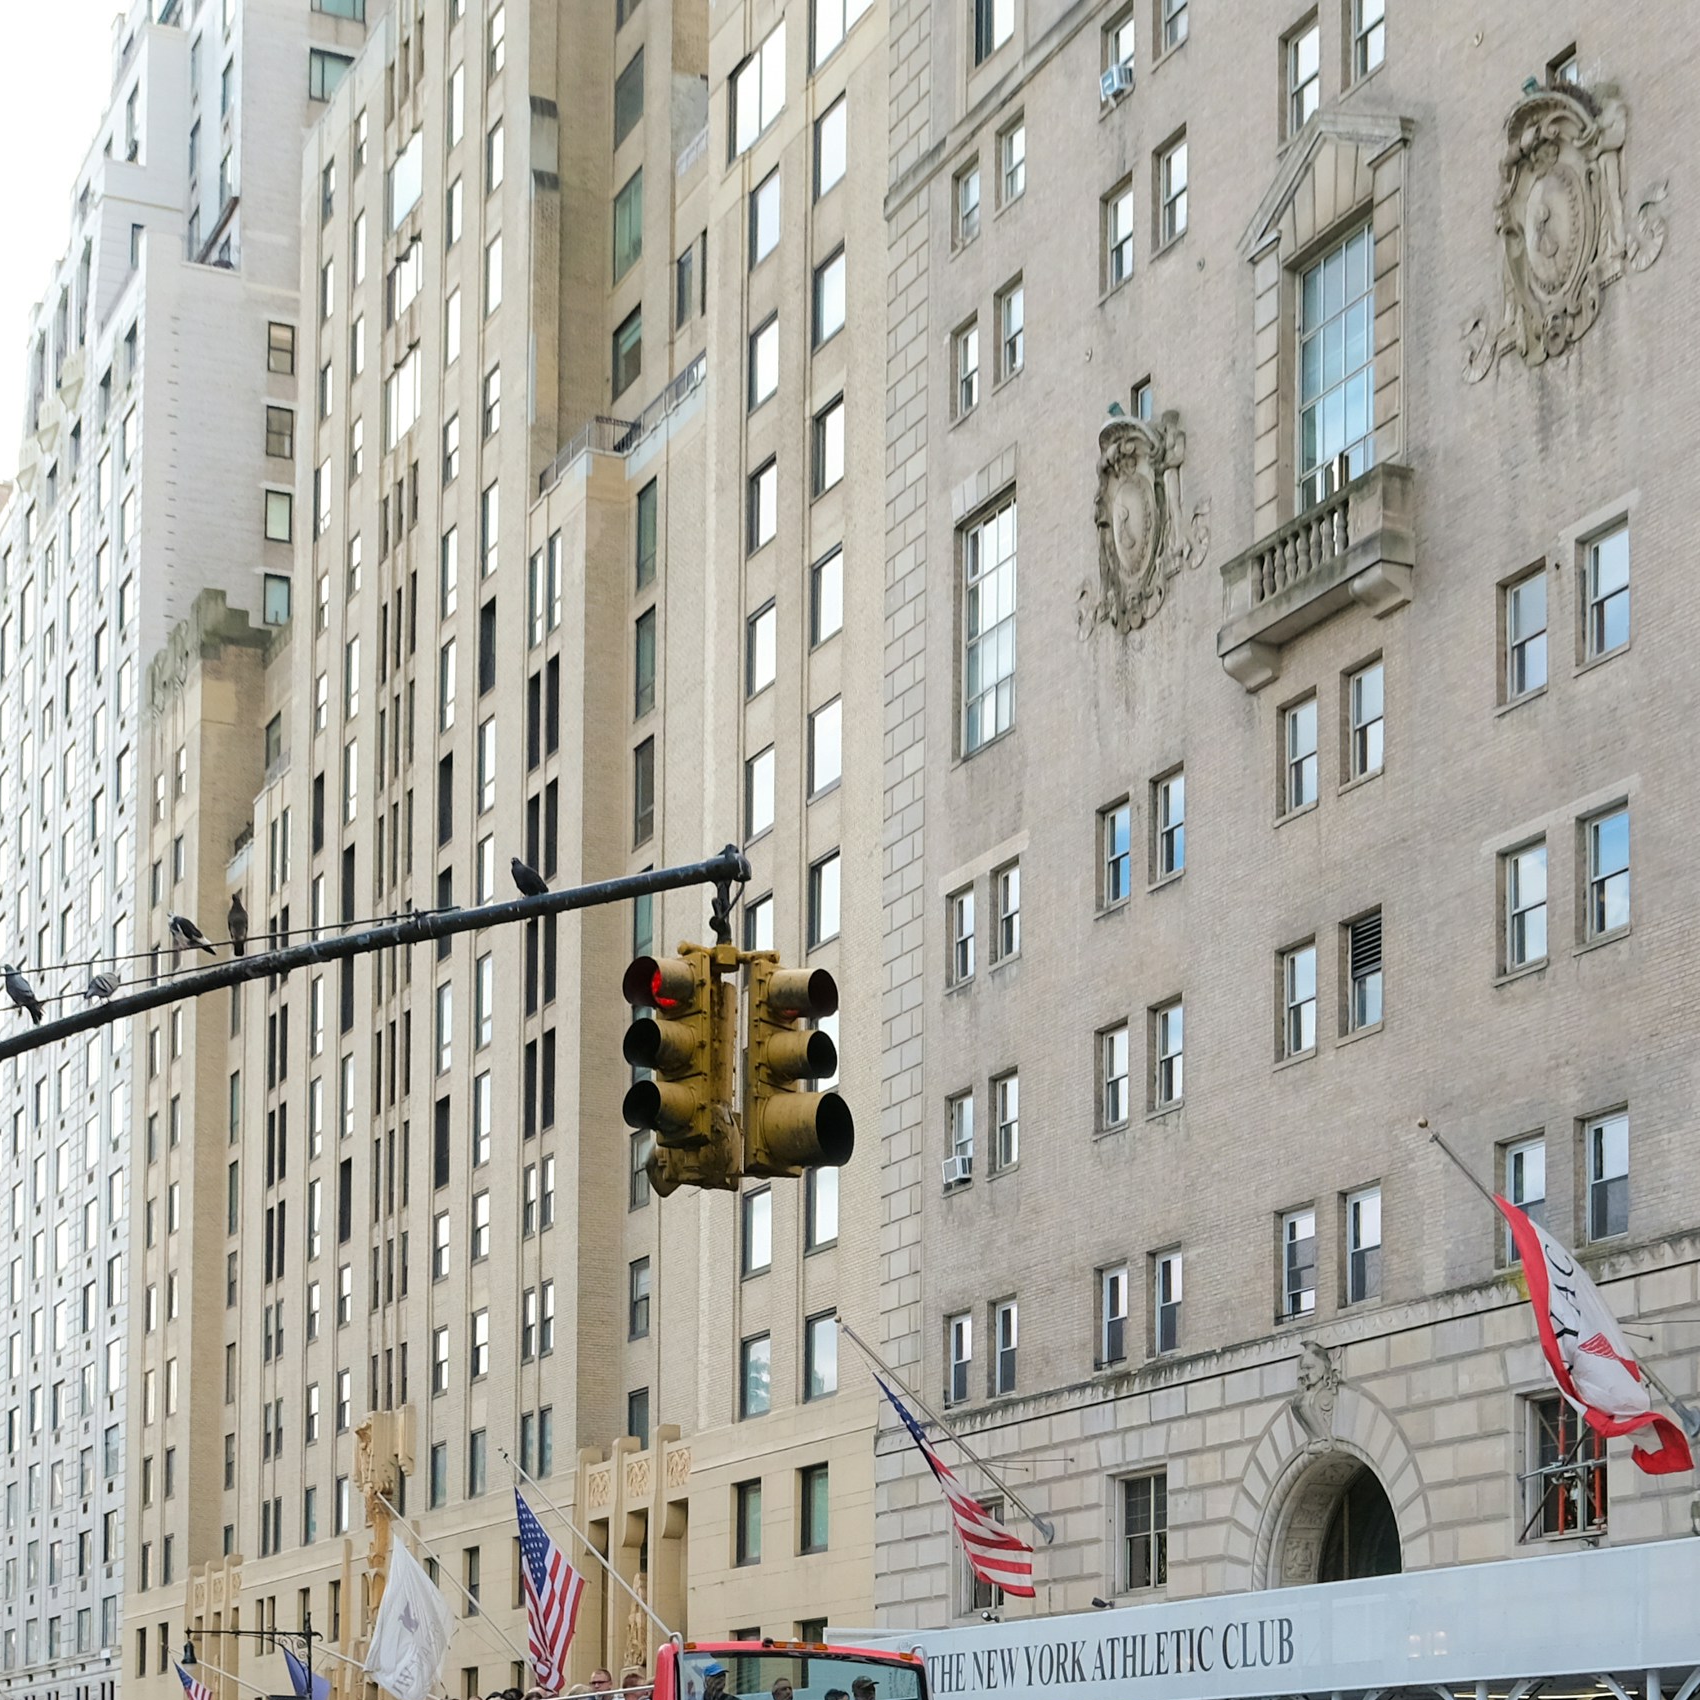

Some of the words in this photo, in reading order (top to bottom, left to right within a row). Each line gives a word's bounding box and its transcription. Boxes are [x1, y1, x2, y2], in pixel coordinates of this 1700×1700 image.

[928, 1654, 966, 1694] THE
[971, 1646, 1020, 1691] NEW
[1024, 1640, 1088, 1687] YORK
[1091, 1625, 1214, 1682] ATHLETIC
[1222, 1617, 1294, 1671] CLUB
